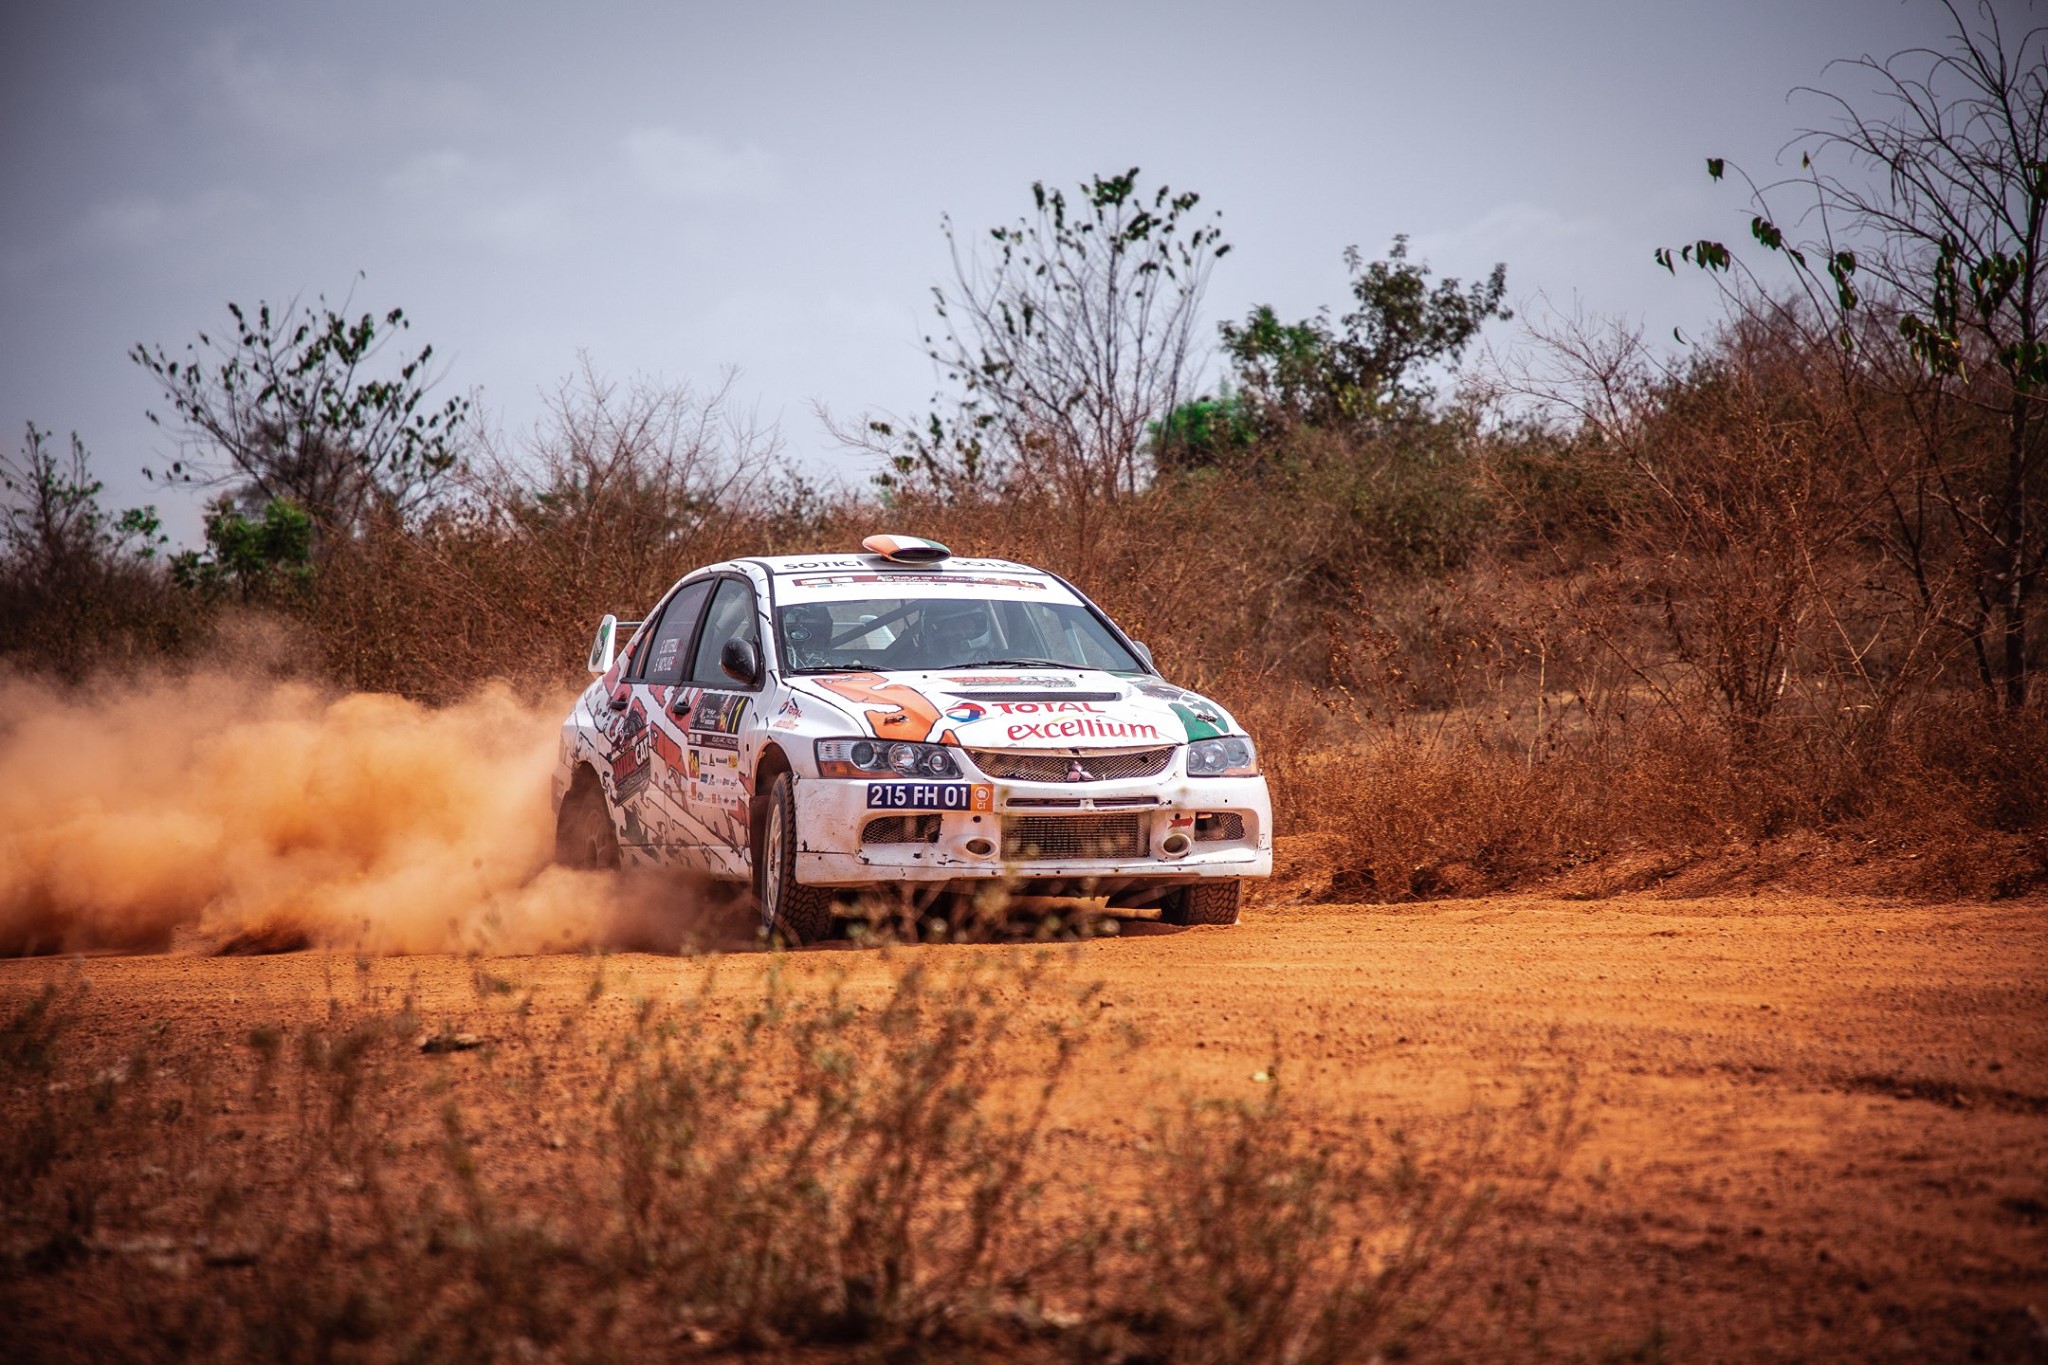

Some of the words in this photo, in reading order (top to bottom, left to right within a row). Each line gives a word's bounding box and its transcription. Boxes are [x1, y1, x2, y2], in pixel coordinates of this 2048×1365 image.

[784, 560, 864, 570] SOTICI
[731, 696, 746, 733] 1
[786, 705, 803, 718] TOTAL
[992, 702, 1106, 714] TOTAL
[1007, 719, 1160, 740] excellium
[613, 748, 635, 782] WILD
[635, 737, 650, 766] CAT
[870, 785, 907, 806] 215
[913, 786, 939, 806] FH
[944, 786, 967, 807] 01
[976, 802, 986, 810] CI
